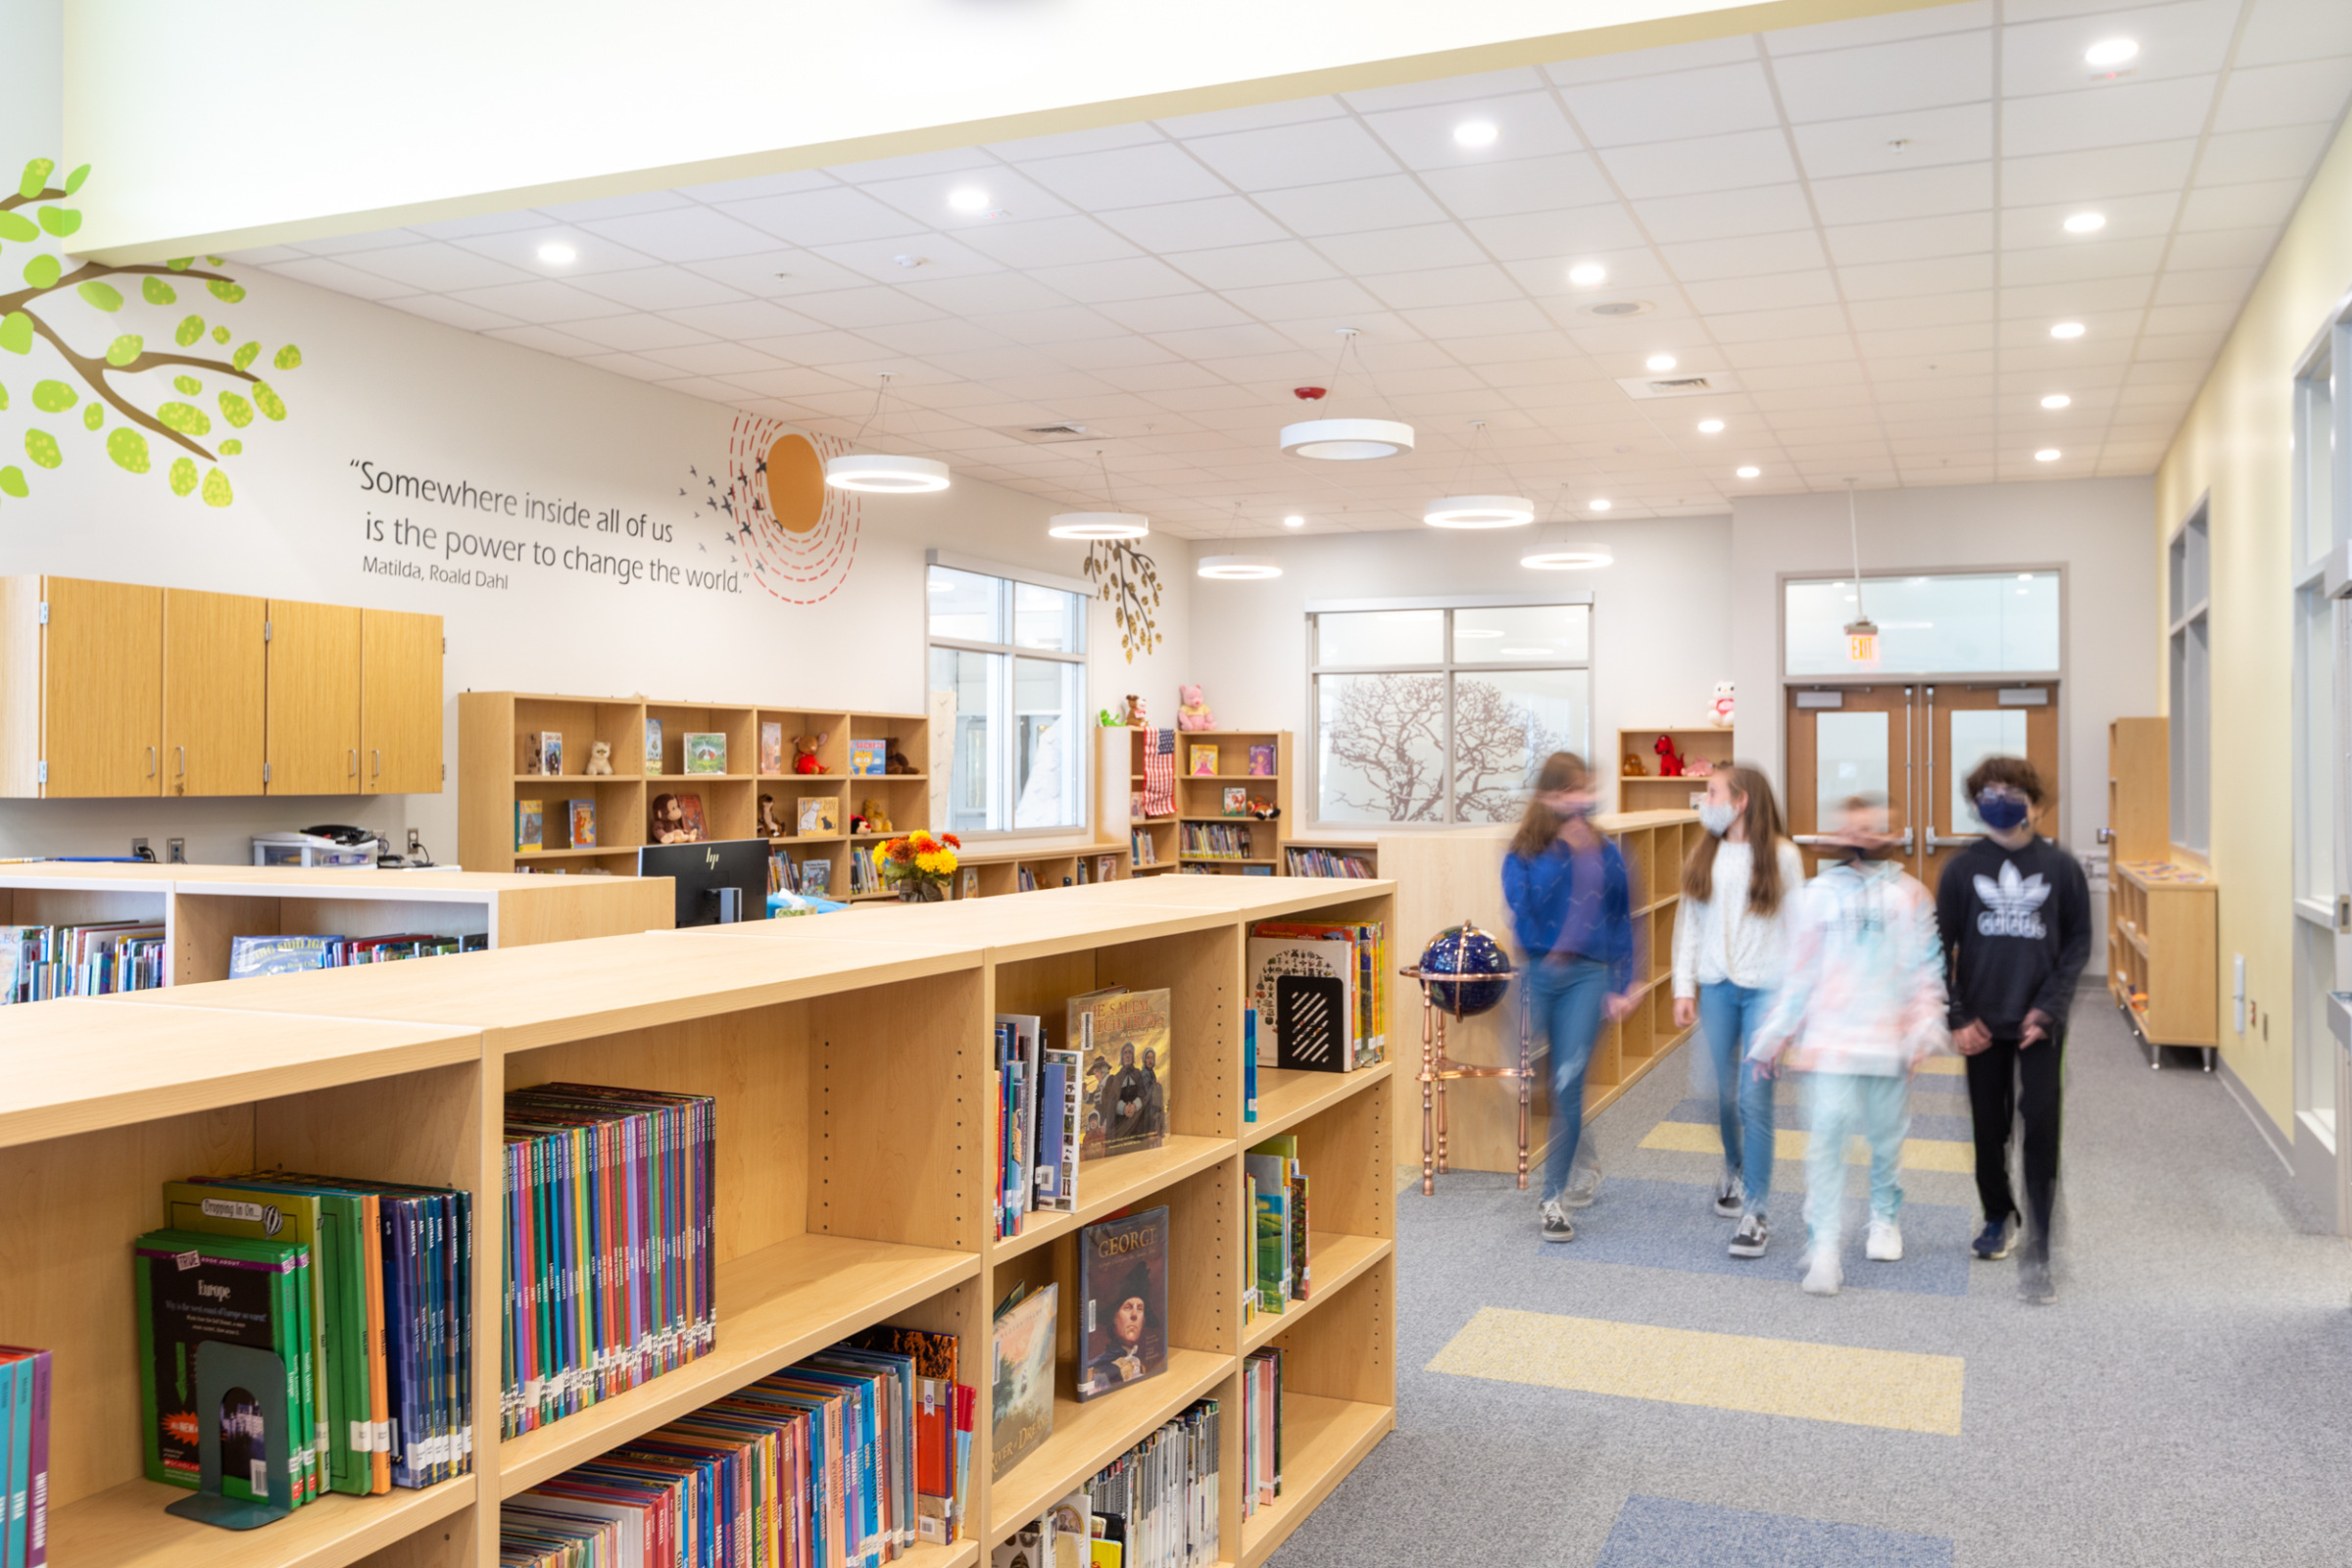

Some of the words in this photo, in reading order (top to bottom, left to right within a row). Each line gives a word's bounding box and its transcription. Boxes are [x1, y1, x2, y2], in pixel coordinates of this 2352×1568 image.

[525, 492, 590, 528] inside
[597, 509, 619, 533] all
[626, 514, 648, 538] of
[652, 522, 672, 543] us
[367, 512, 384, 541] is
[394, 517, 437, 550] the
[446, 530, 525, 562] power
[533, 541, 556, 566] to
[564, 545, 643, 585] change
[649, 558, 680, 584] the
[363, 556, 424, 581] Matilda,
[429, 564, 470, 585] Roald
[475, 570, 508, 589] Dahl
[1851, 636, 1873, 660] EXIT
[706, 847, 719, 870] hp
[1977, 908, 2047, 940] adidas
[1109, 1000, 1151, 1015] SALEM
[1124, 1011, 1166, 1031] TRIALS
[198, 1279, 231, 1302] Europe
